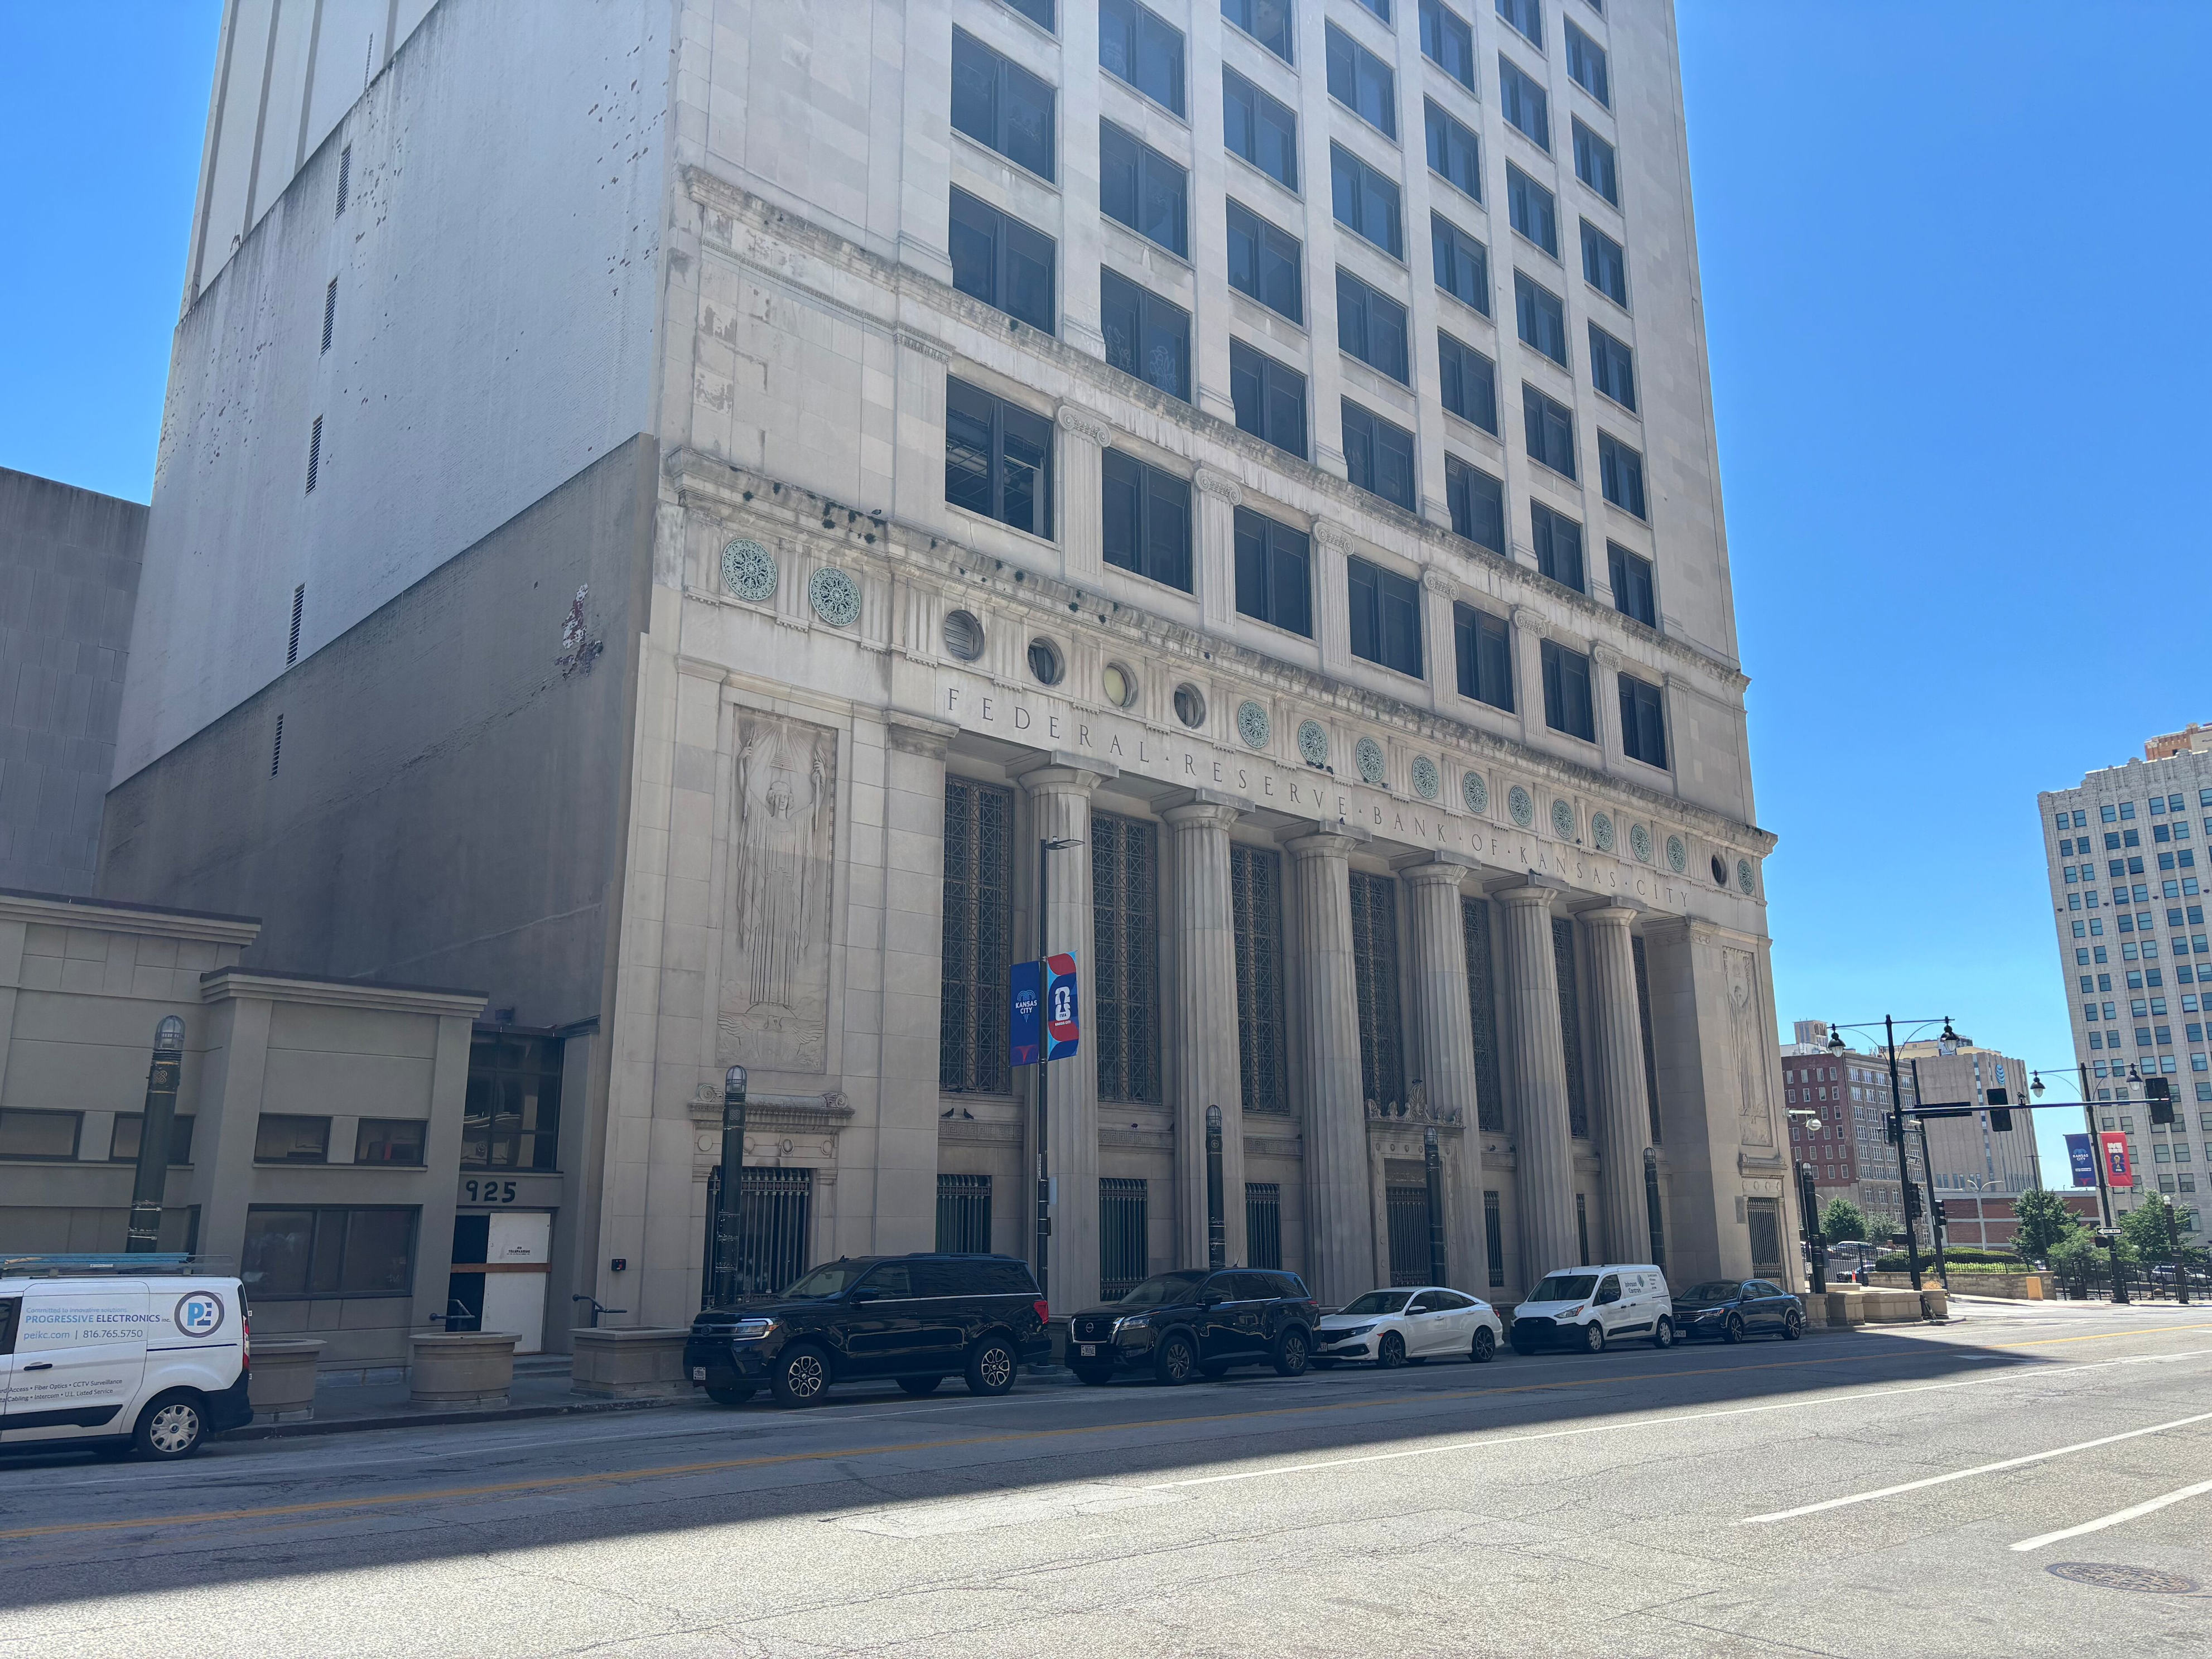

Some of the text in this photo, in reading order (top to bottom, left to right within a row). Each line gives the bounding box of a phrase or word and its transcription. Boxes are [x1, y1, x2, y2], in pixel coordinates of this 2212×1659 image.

[948, 687, 1688, 907] FEDERAL RESERVE BANK OF KANSAS CITY
[1015, 1000, 1037, 1009] KANSAS
[465, 1180, 517, 1203] 925
[26, 1315, 94, 1323] PROGRESSIVE
[97, 1314, 161, 1323] ELECTRONICS
[23, 1329, 143, 1341] peikc.com 816.765.5750
